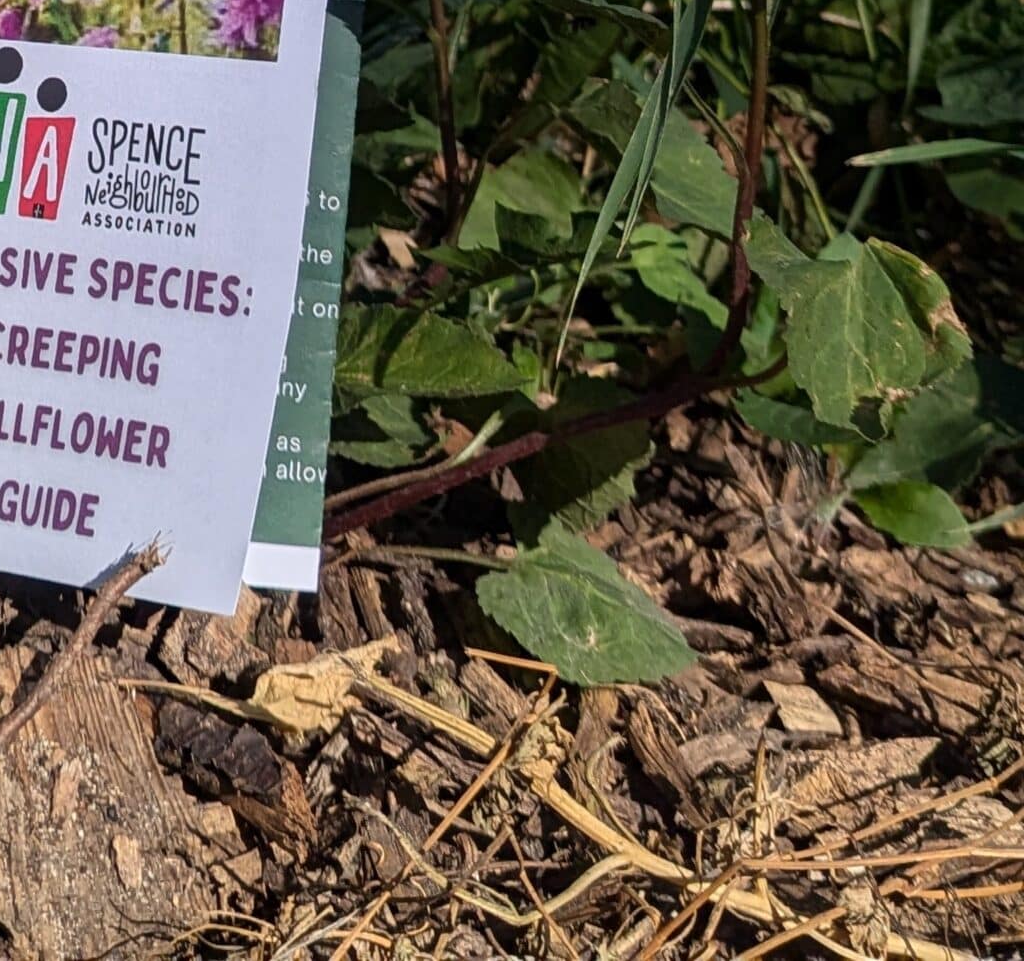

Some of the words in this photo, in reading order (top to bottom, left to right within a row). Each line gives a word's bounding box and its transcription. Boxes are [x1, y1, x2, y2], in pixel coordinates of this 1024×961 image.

[87, 117, 206, 185] SPENCE
[318, 189, 340, 211] to
[81, 210, 196, 238] ASSOCIATION
[87, 258, 253, 317] SPECIES:
[312, 302, 340, 319] on
[276, 435, 302, 453] as
